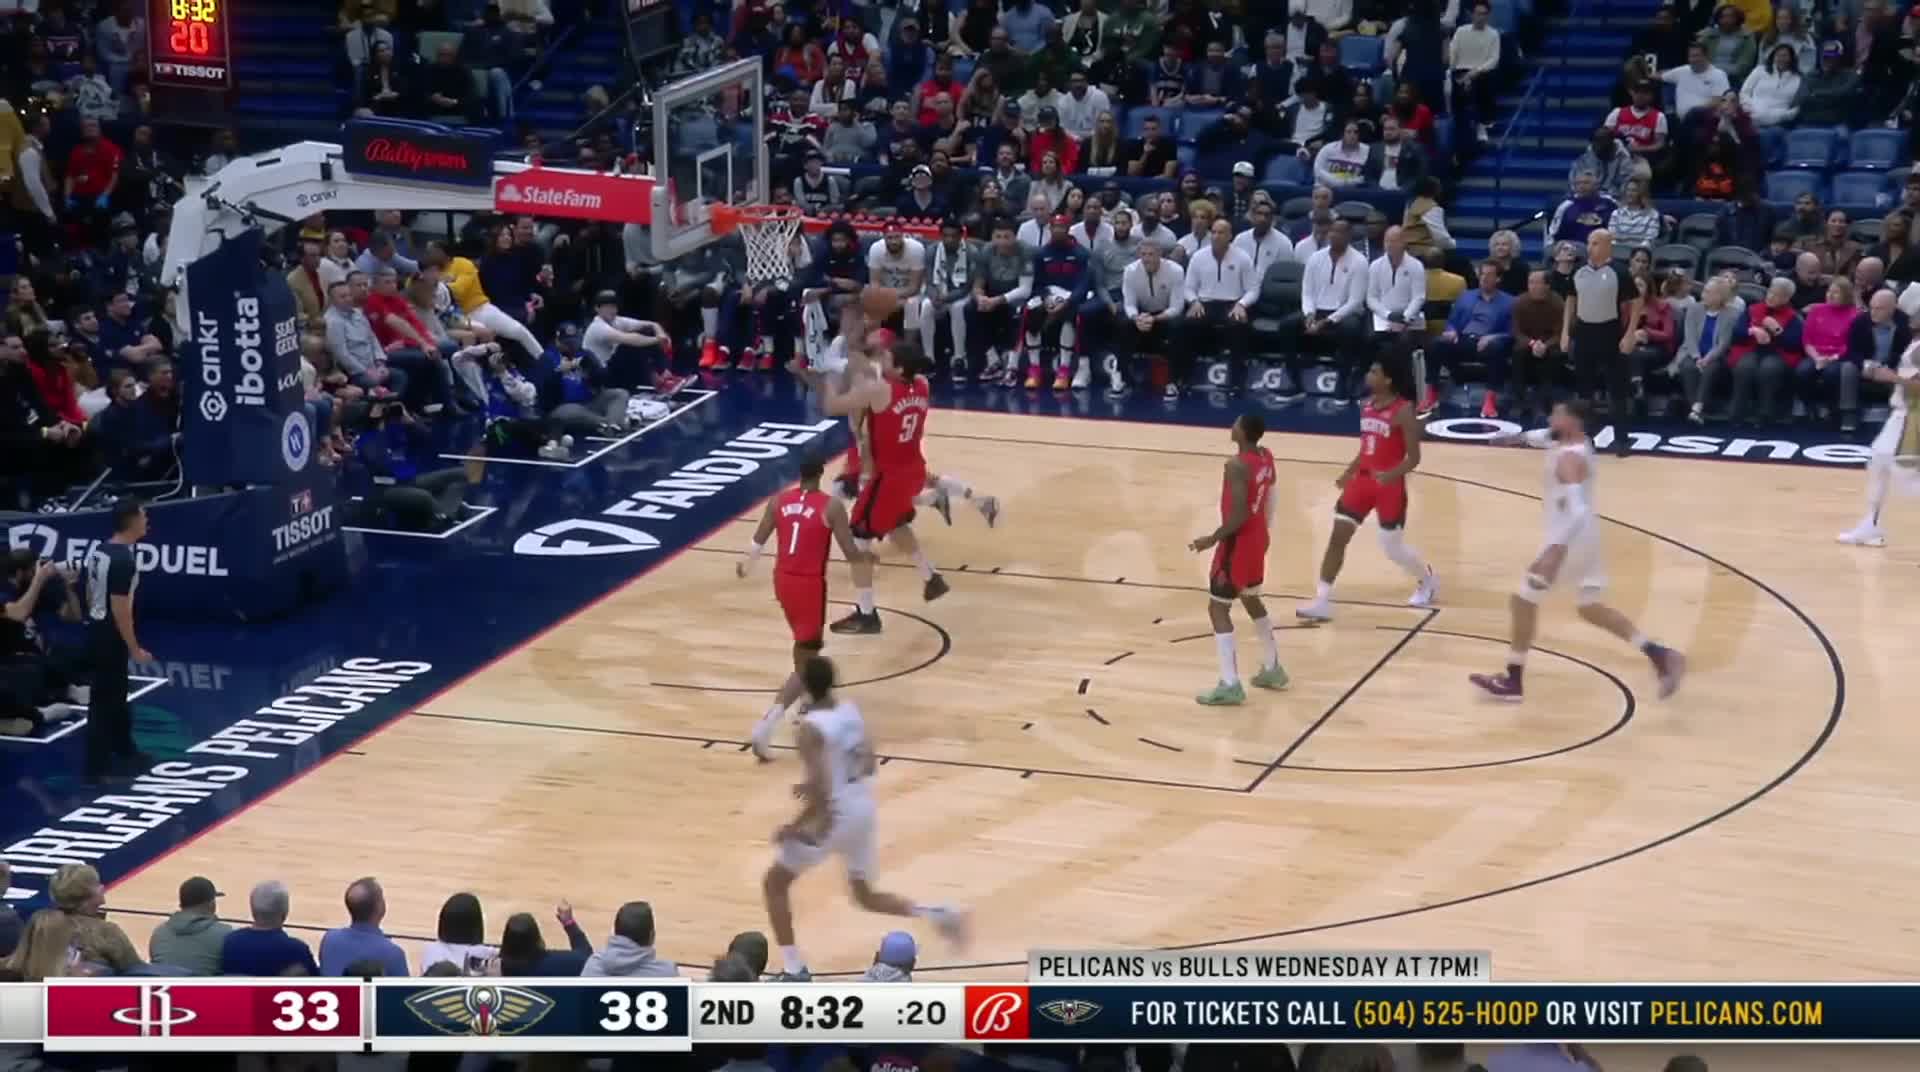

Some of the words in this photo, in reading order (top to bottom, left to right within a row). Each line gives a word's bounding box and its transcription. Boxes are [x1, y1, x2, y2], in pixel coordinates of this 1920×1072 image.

[171, 0, 216, 22] 8:32
[170, 20, 209, 55] 20
[174, 63, 225, 79] TISSOT
[198, 311, 222, 386] ankr
[234, 296, 266, 406] ibotta
[1208, 363, 1229, 385] G
[1263, 368, 1282, 389] G
[1316, 371, 1338, 393] G
[602, 419, 840, 520] FANDUEL
[271, 505, 333, 551] TISSOT
[788, 520, 800, 556] 1
[186, 656, 433, 759] PELICANS
